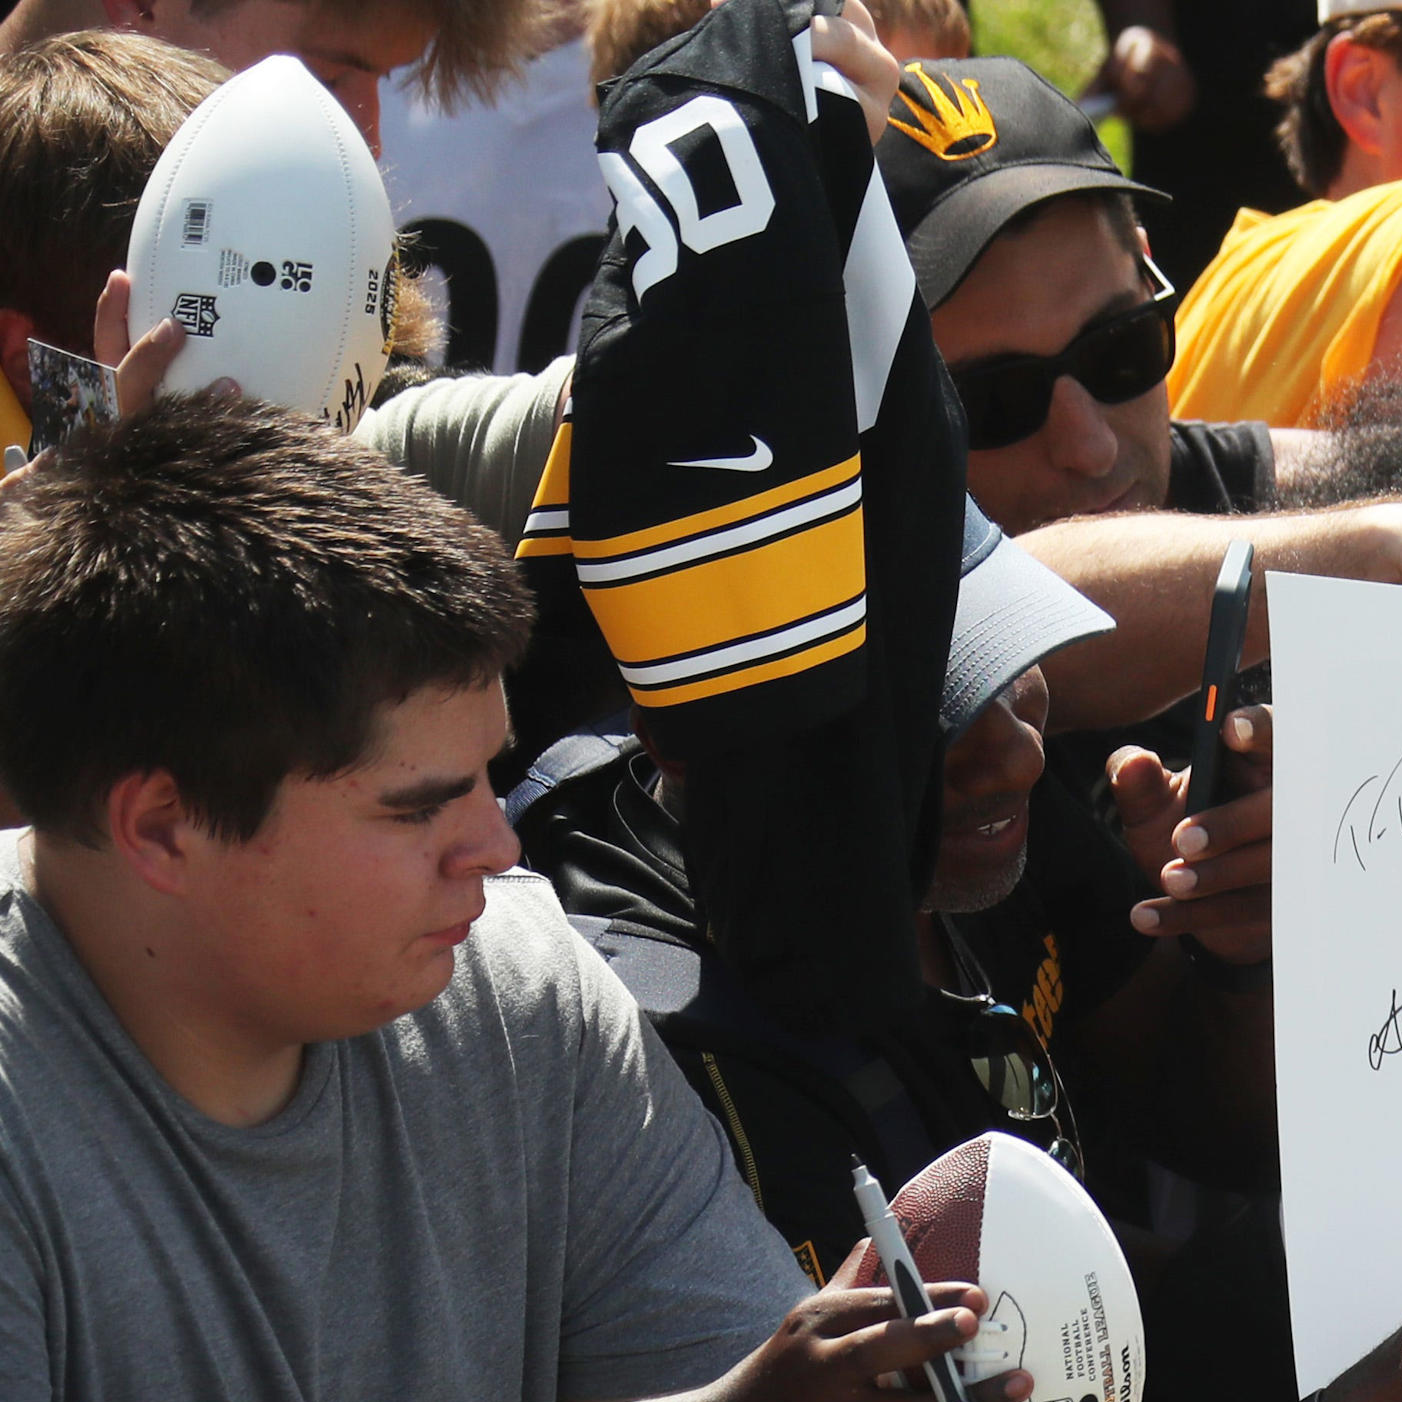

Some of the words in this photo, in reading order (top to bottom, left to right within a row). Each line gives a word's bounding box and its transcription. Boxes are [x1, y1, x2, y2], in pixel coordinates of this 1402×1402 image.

[364, 269, 379, 316] 2025
[1084, 1271, 1110, 1344] LEAGUE
[1060, 1322, 1075, 1381] NATIONAL
[1071, 1319, 1086, 1378] FOOTBALL
[1080, 1307, 1097, 1382] CONFERENCE
